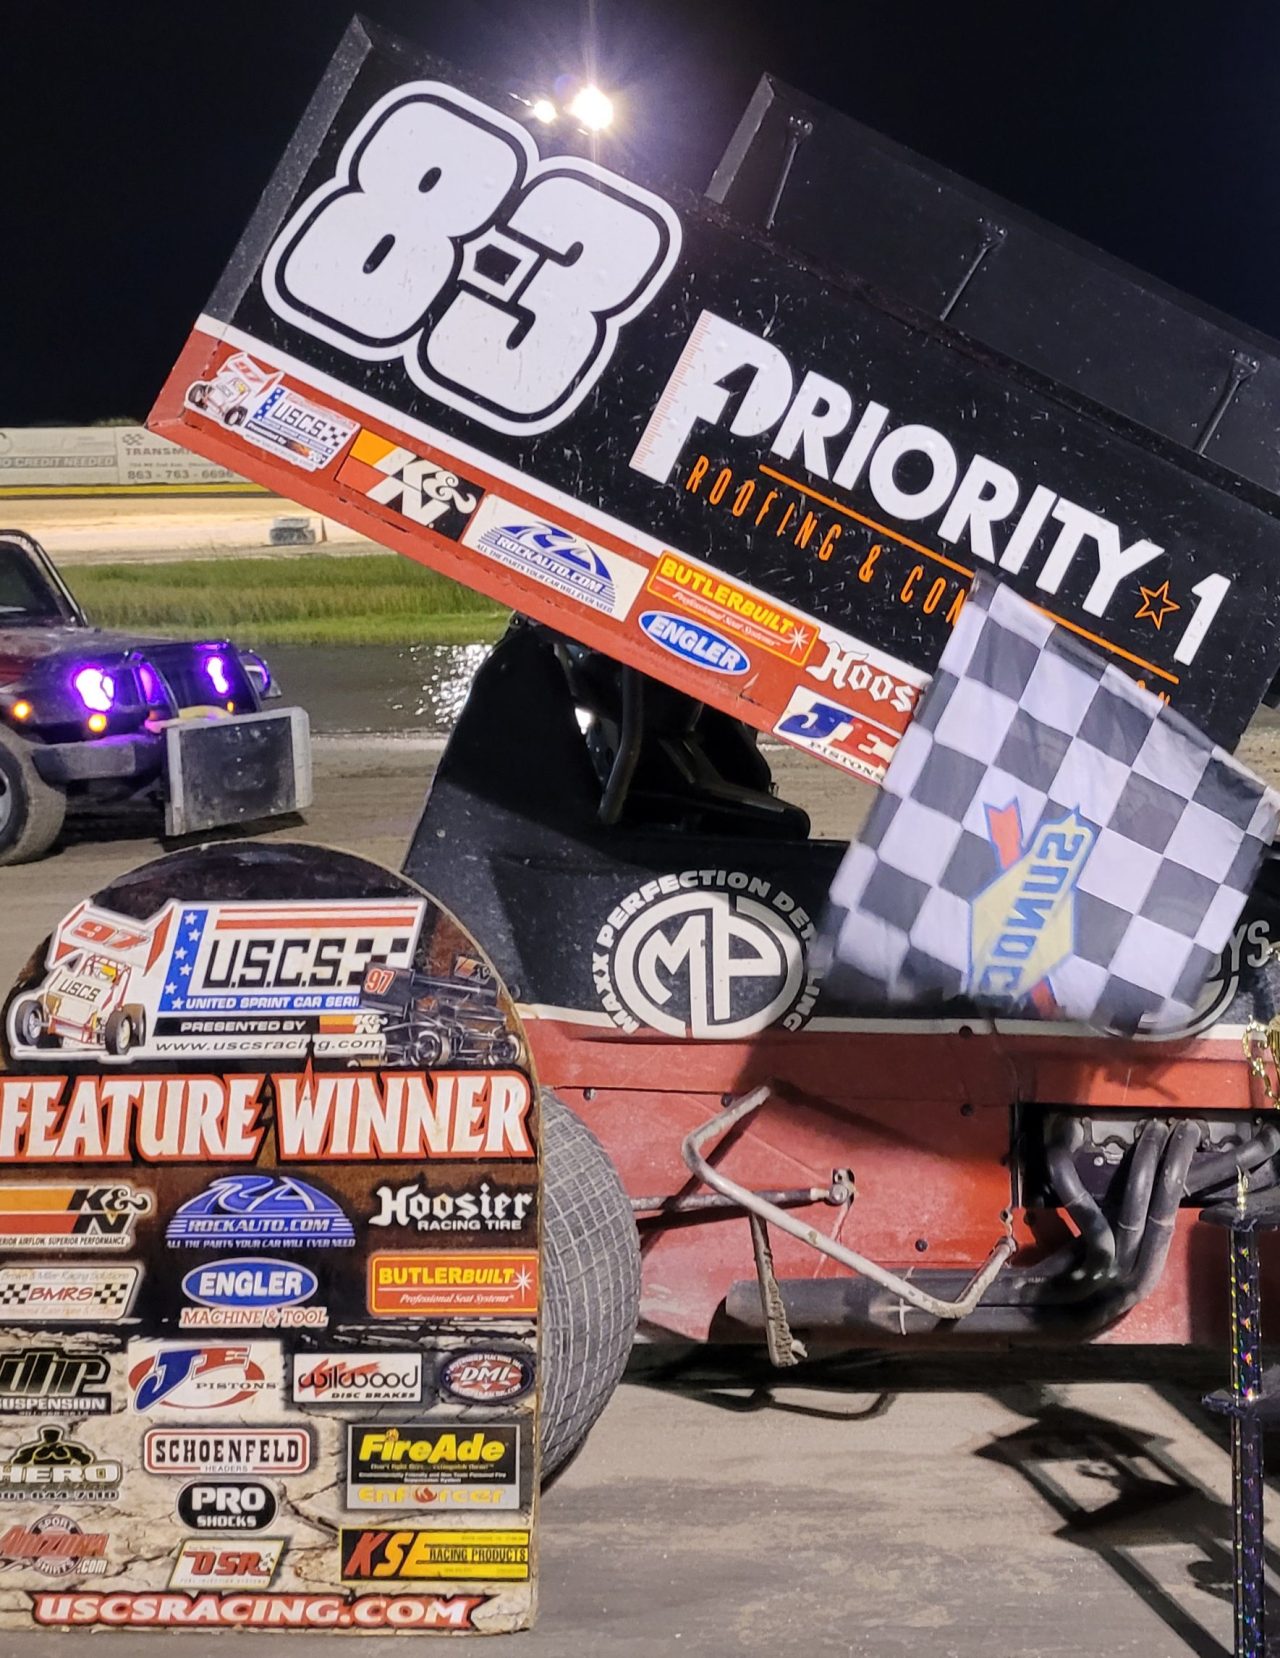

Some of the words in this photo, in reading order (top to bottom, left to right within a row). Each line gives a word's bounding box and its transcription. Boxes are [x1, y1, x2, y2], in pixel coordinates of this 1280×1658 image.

[262, 80, 683, 437] 83
[15, 457, 61, 468] CREDIT
[64, 457, 114, 468] NEEDED
[628, 308, 1165, 617] PRIORITY
[1173, 572, 1232, 665] 1
[685, 455, 841, 563] ROOFING
[857, 545, 885, 584] &
[900, 566, 967, 627] CON
[495, 535, 605, 593] ROCKAUTO.COM
[502, 555, 525, 571] PARTS
[526, 566, 545, 580] YOUR
[545, 575, 560, 588] CAR
[661, 558, 795, 635] BUTLERBUILT
[648, 614, 741, 671] ENGLER
[806, 641, 916, 712] Hoos
[596, 869, 772, 948] PERFECTION
[72, 920, 150, 951] 97
[772, 890, 826, 1032] DETLING
[363, 967, 396, 996] 97
[592, 951, 641, 1035] MAXX
[186, 997, 237, 1009] UNITED
[240, 997, 292, 1009] SPRINT
[294, 996, 323, 1008] CAR
[325, 995, 360, 1008] SERI
[180, 1021, 279, 1033] PRESENTED
[282, 1020, 306, 1032] BY
[156, 1038, 385, 1052] www.uscsracig.com
[0, 1077, 264, 1160] FEATURE
[278, 1074, 534, 1159] WINNER
[67, 1185, 152, 1236] K&N
[368, 1182, 533, 1227] Hoosier
[188, 1218, 331, 1233] ROCKAUTO.COM
[417, 1220, 481, 1231] RACING
[485, 1219, 522, 1231] TIRE
[48, 1237, 78, 1246] SUPERIOR
[203, 1240, 234, 1249] PARTS
[236, 1239, 261, 1249] YOUR
[262, 1239, 282, 1249] CAR
[283, 1239, 304, 1248] WILL
[332, 1238, 356, 1248] NEED
[199, 1270, 304, 1297] ENGLER
[379, 1267, 515, 1285] BUTLERBUILT
[28, 1286, 94, 1302] BMRS
[400, 1294, 453, 1305] Professional
[454, 1294, 473, 1304] Seat
[183, 1311, 263, 1325] MACHINE
[265, 1311, 278, 1325] &
[283, 1310, 328, 1325] TOOL
[196, 1382, 278, 1391] PISTONS
[297, 1364, 420, 1389] wilwood
[460, 1366, 511, 1382] DMI
[331, 1392, 361, 1400] DISC
[365, 1391, 416, 1400] BRAKES
[155, 1439, 299, 1463] SCHOENFELD
[359, 1432, 506, 1464] FireAde
[205, 1465, 248, 1473] HEADERS
[191, 1487, 267, 1514] PRO
[38, 1517, 73, 1530] SPORT
[196, 1516, 257, 1528] SHOCKS
[344, 1532, 430, 1578] KSE
[430, 1548, 468, 1562] RACING
[471, 1548, 527, 1562] PRODUCTS
[36, 1594, 469, 1627] USCSRACING.COM
